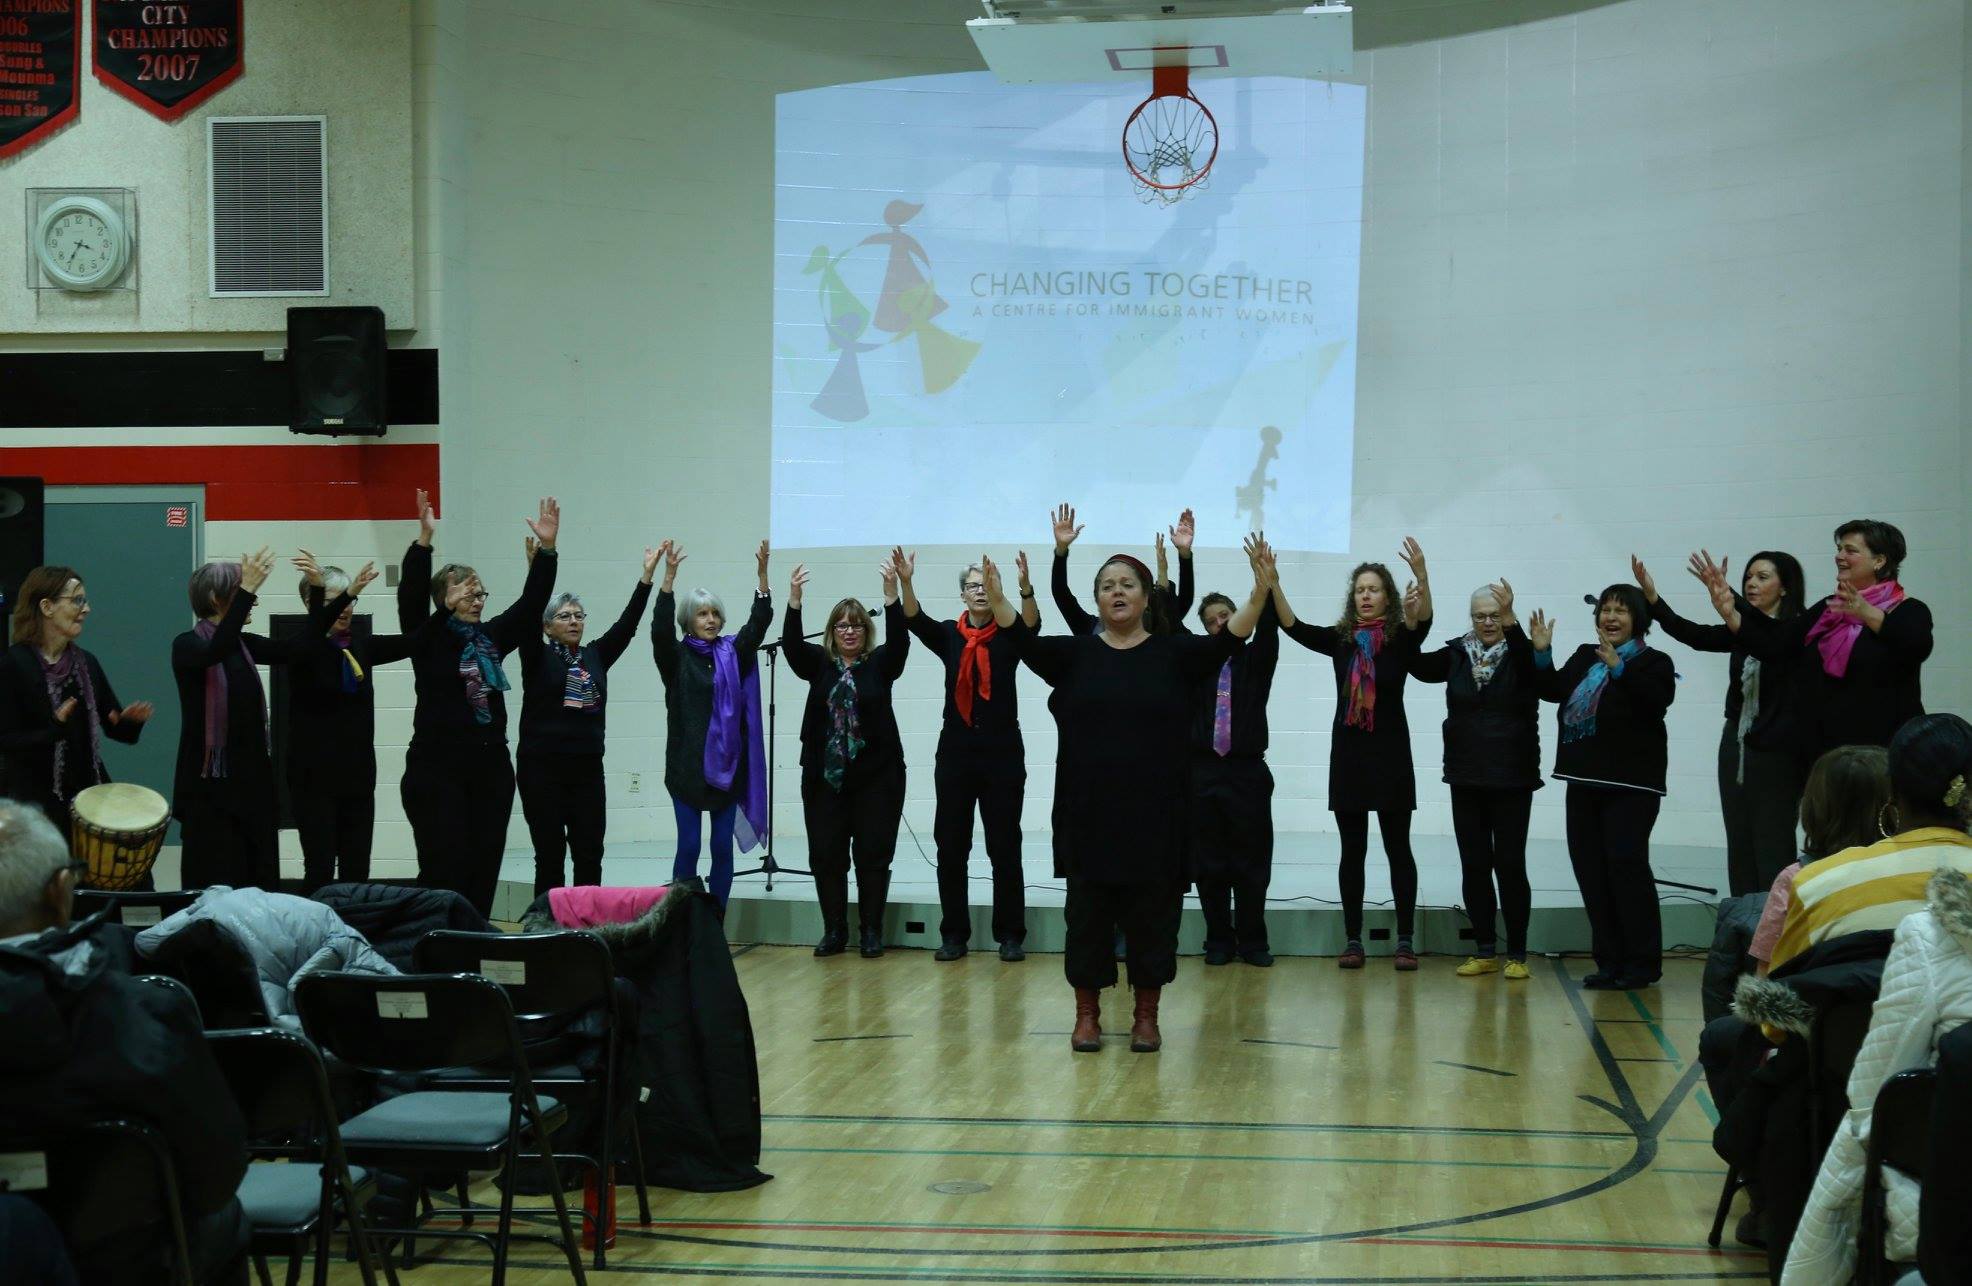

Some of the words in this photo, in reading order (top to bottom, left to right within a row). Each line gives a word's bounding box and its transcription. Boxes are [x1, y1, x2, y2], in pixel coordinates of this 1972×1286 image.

[0, 0, 70, 13] AMPIONS
[141, 5, 191, 25] CITY
[108, 28, 228, 50] CHAMPIONS
[137, 53, 201, 81] 2007
[970, 271, 1131, 297] CHANGING
[1143, 271, 1313, 305] TOGETHER
[972, 305, 983, 318] A
[991, 303, 1057, 318] CENTRE
[1066, 303, 1100, 317] FOR
[1109, 303, 1225, 320] IMMIGRANT
[1235, 308, 1314, 326] WOMEN
